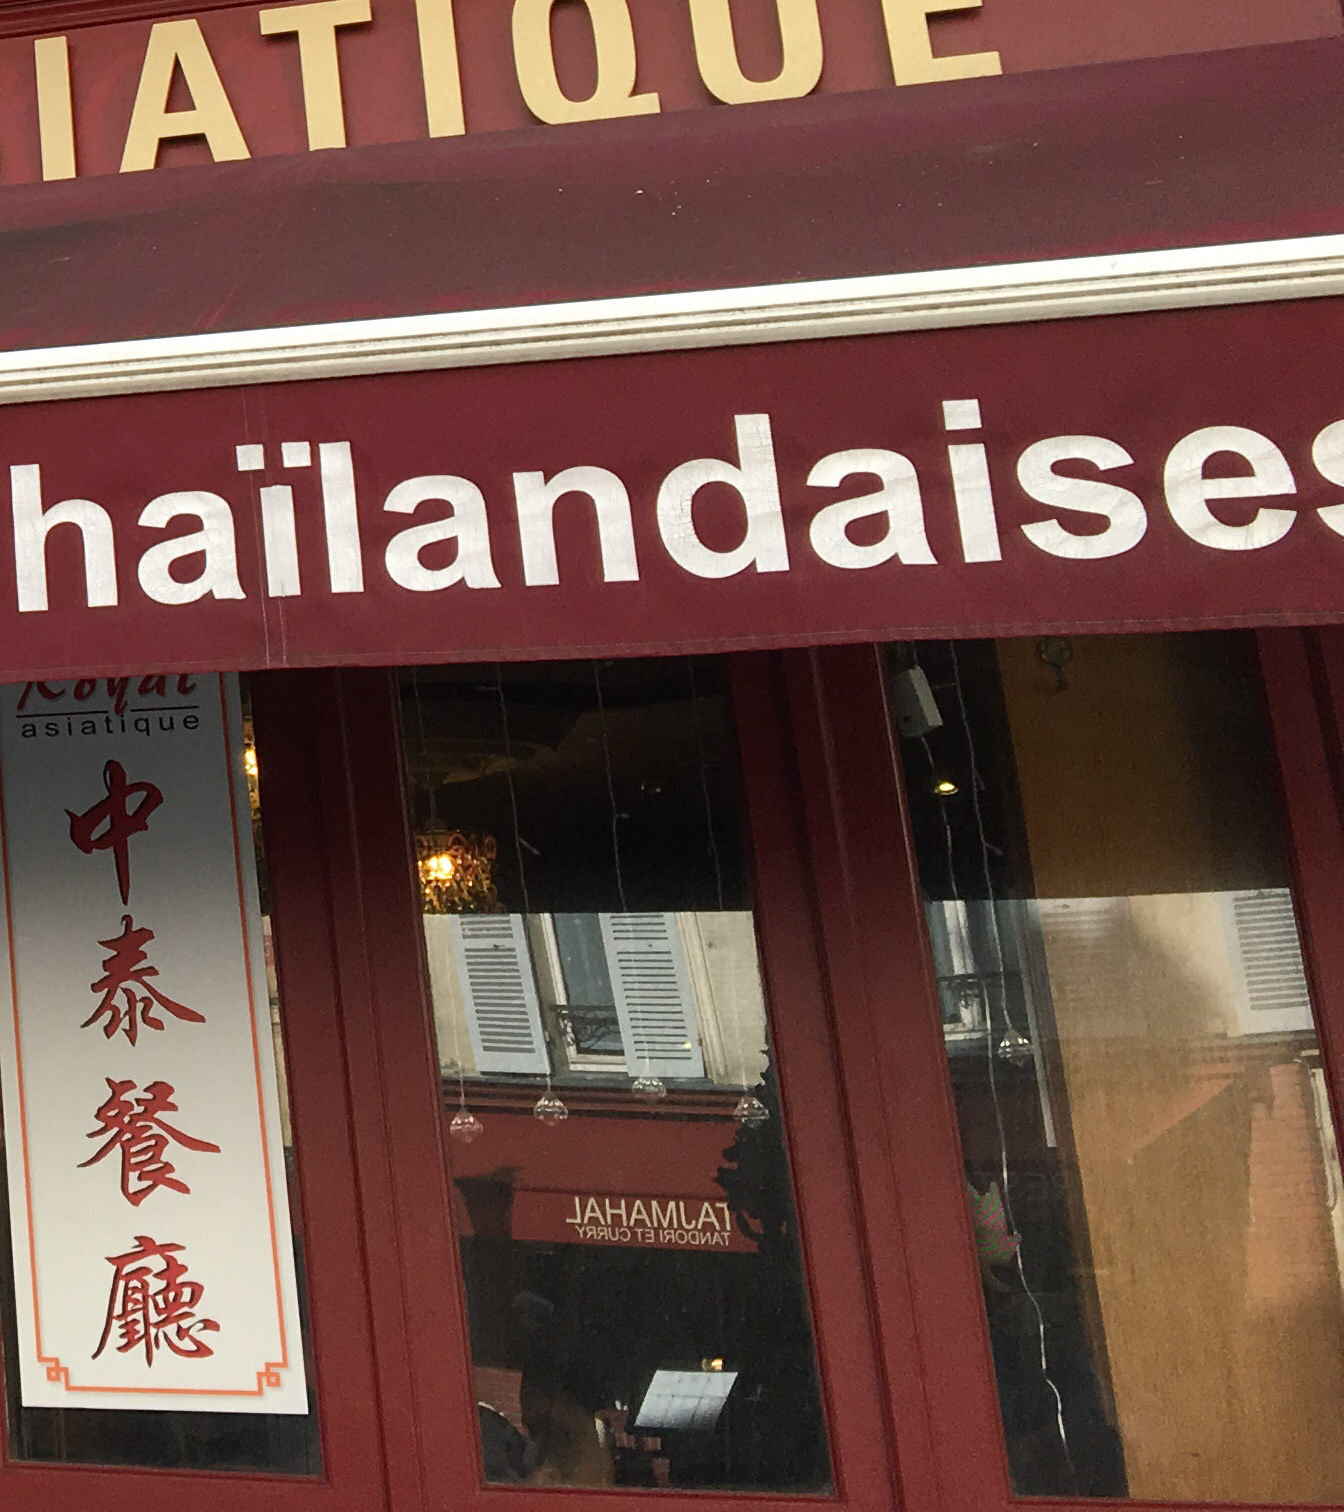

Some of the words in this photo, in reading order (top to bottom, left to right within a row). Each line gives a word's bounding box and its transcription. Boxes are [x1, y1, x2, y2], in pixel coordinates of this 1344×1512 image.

[21, 714, 200, 738] asiatique
[65, 759, 222, 1368] 中泰餐廳
